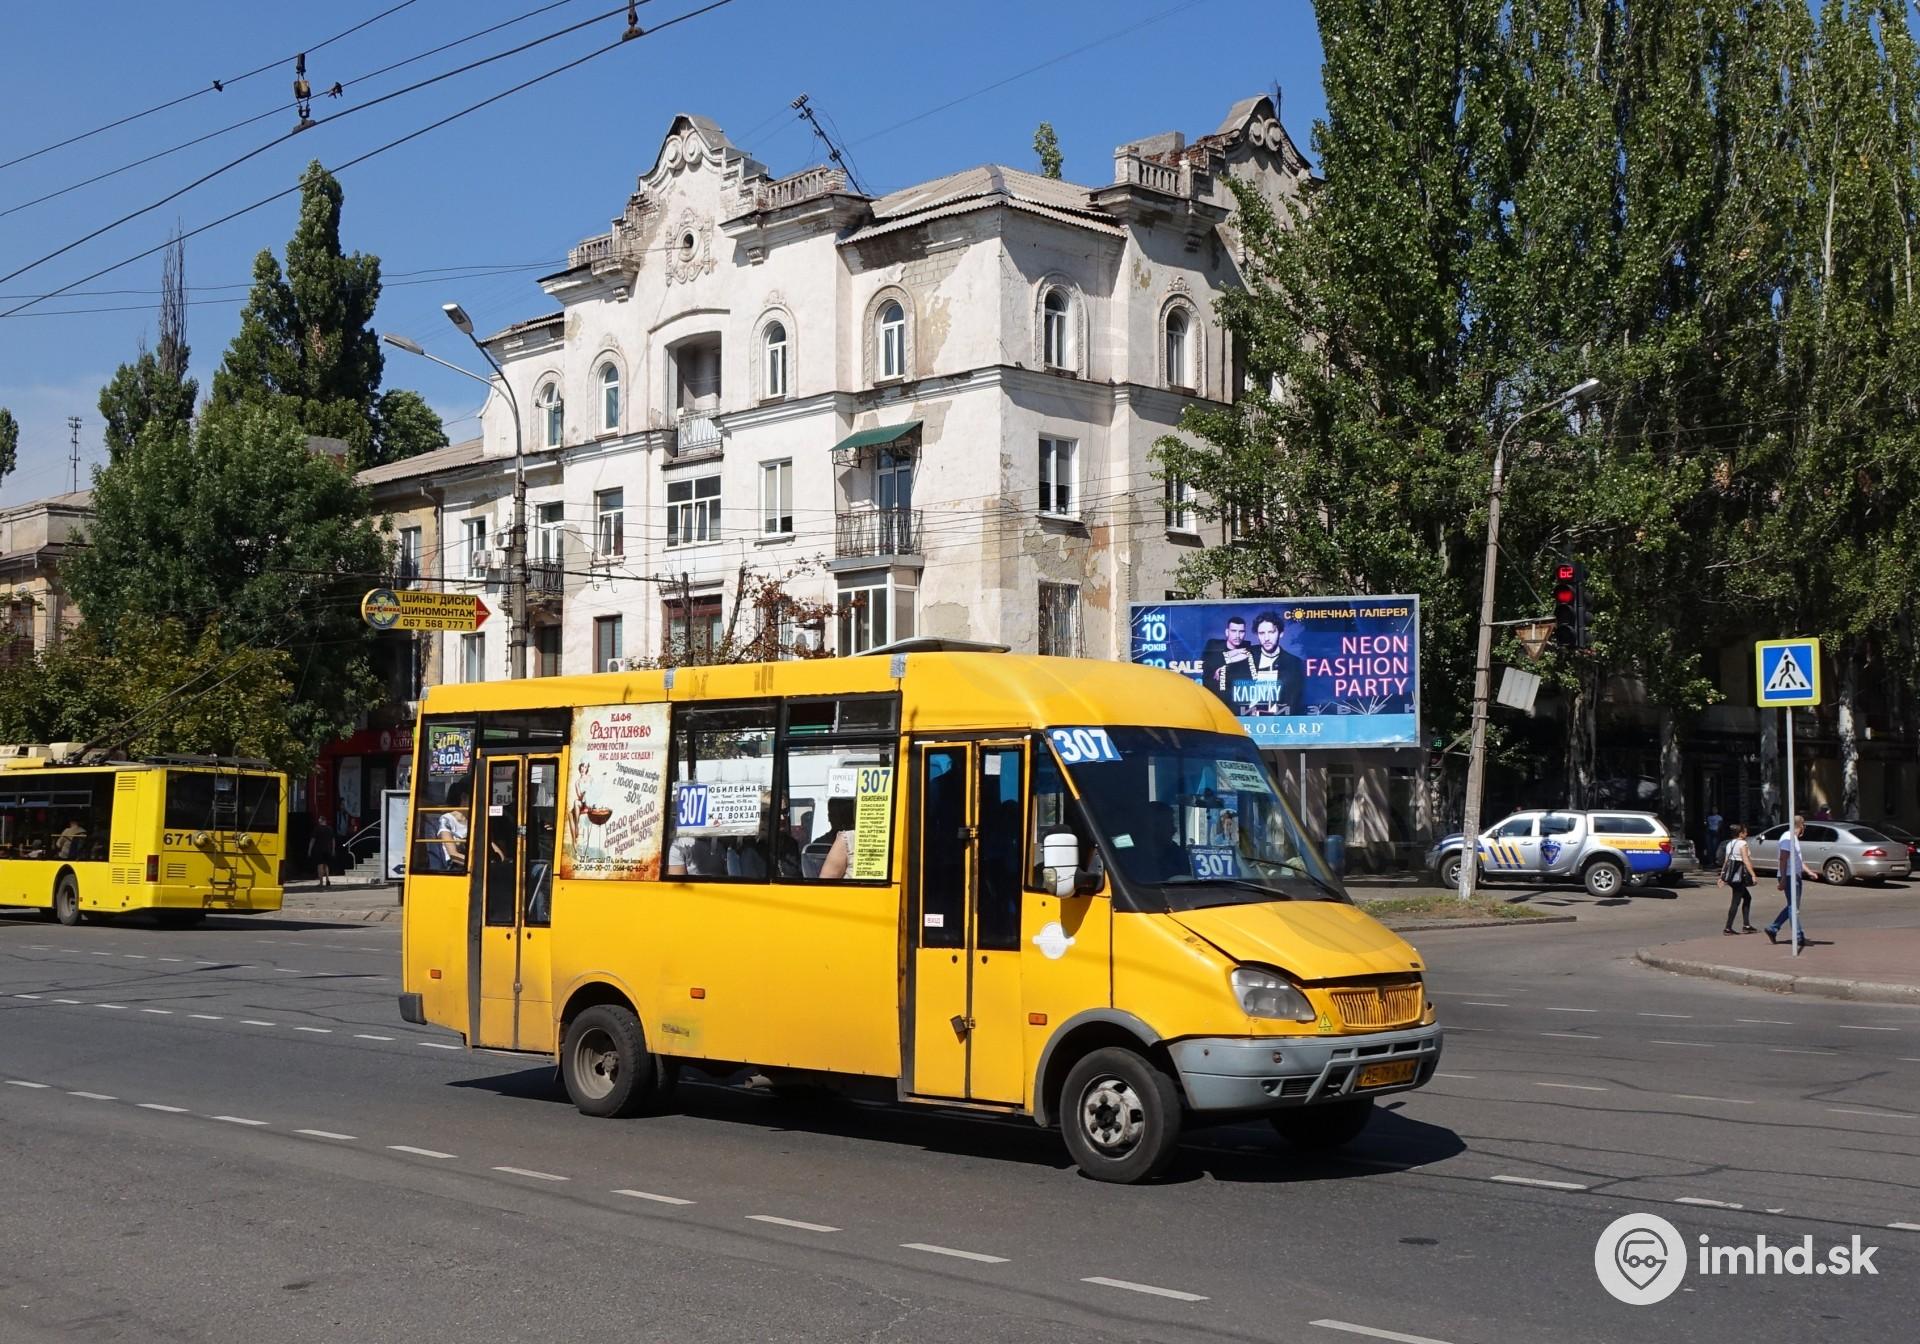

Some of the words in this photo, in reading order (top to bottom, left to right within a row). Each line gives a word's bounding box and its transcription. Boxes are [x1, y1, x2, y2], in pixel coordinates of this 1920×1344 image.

[402, 593, 436, 604] ШИНЫ
[440, 596, 475, 606] ДИСКИ
[401, 606, 475, 617] ШИНОМОНТАЖ
[1143, 614, 1165, 622] НАМ
[1360, 607, 1408, 617] ГАЛЕРЕЯ
[403, 619, 420, 627] 067
[425, 619, 443, 628] 568
[447, 621, 464, 629] 777
[1142, 622, 1167, 641] 10
[1342, 635, 1408, 655] NEON
[1168, 660, 1204, 674] SALE
[1306, 656, 1408, 677] FASHION
[1233, 685, 1281, 702] KADNAY
[1335, 677, 1409, 697] PARTY
[1243, 722, 1321, 734] ROCARD
[1053, 729, 1114, 761] 307
[861, 769, 890, 793] 307
[709, 784, 762, 793] ЮБИЛЕЙНАЯ
[680, 789, 706, 825] 307
[728, 812, 760, 820] ВОКЗАЛ
[164, 833, 193, 846] 671
[1195, 854, 1232, 876] 307
